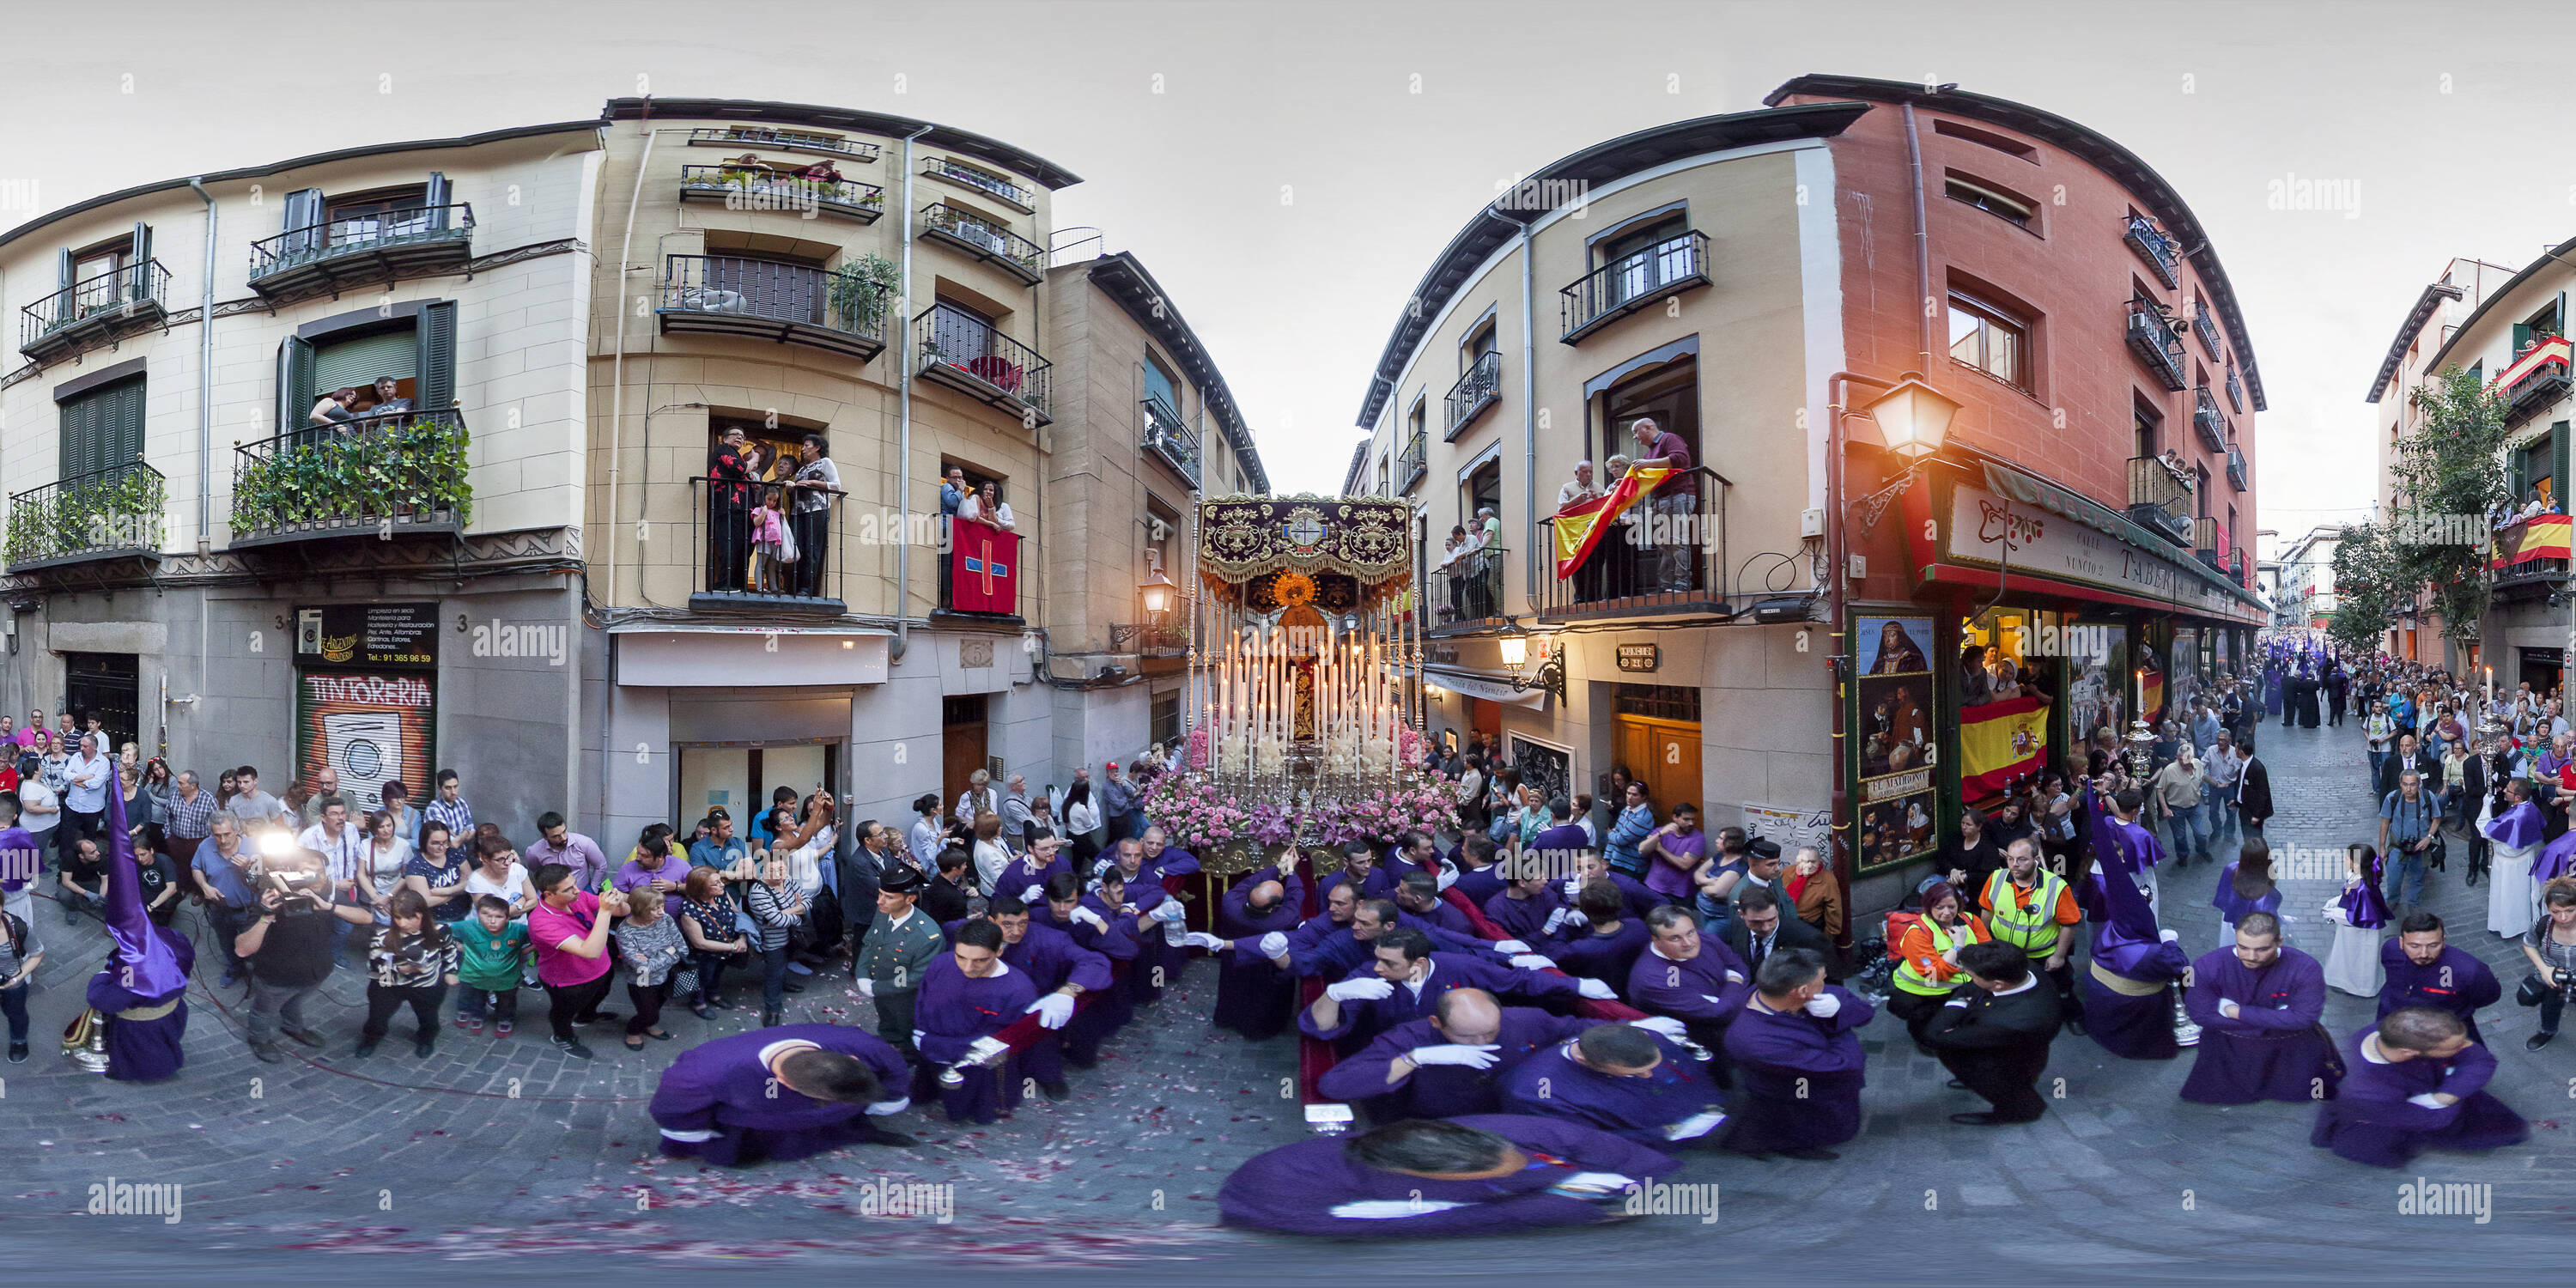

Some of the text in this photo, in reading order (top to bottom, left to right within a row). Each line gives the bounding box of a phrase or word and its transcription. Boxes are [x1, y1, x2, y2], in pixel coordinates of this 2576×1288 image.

[2076, 532, 2101, 550] CALLE
[2066, 556, 2104, 576] NUNCIO 2
[2120, 549, 2184, 596] TABERA
[276, 615, 283, 630] 3
[457, 614, 468, 633] 3
[1479, 684, 1508, 697] Nuncio
